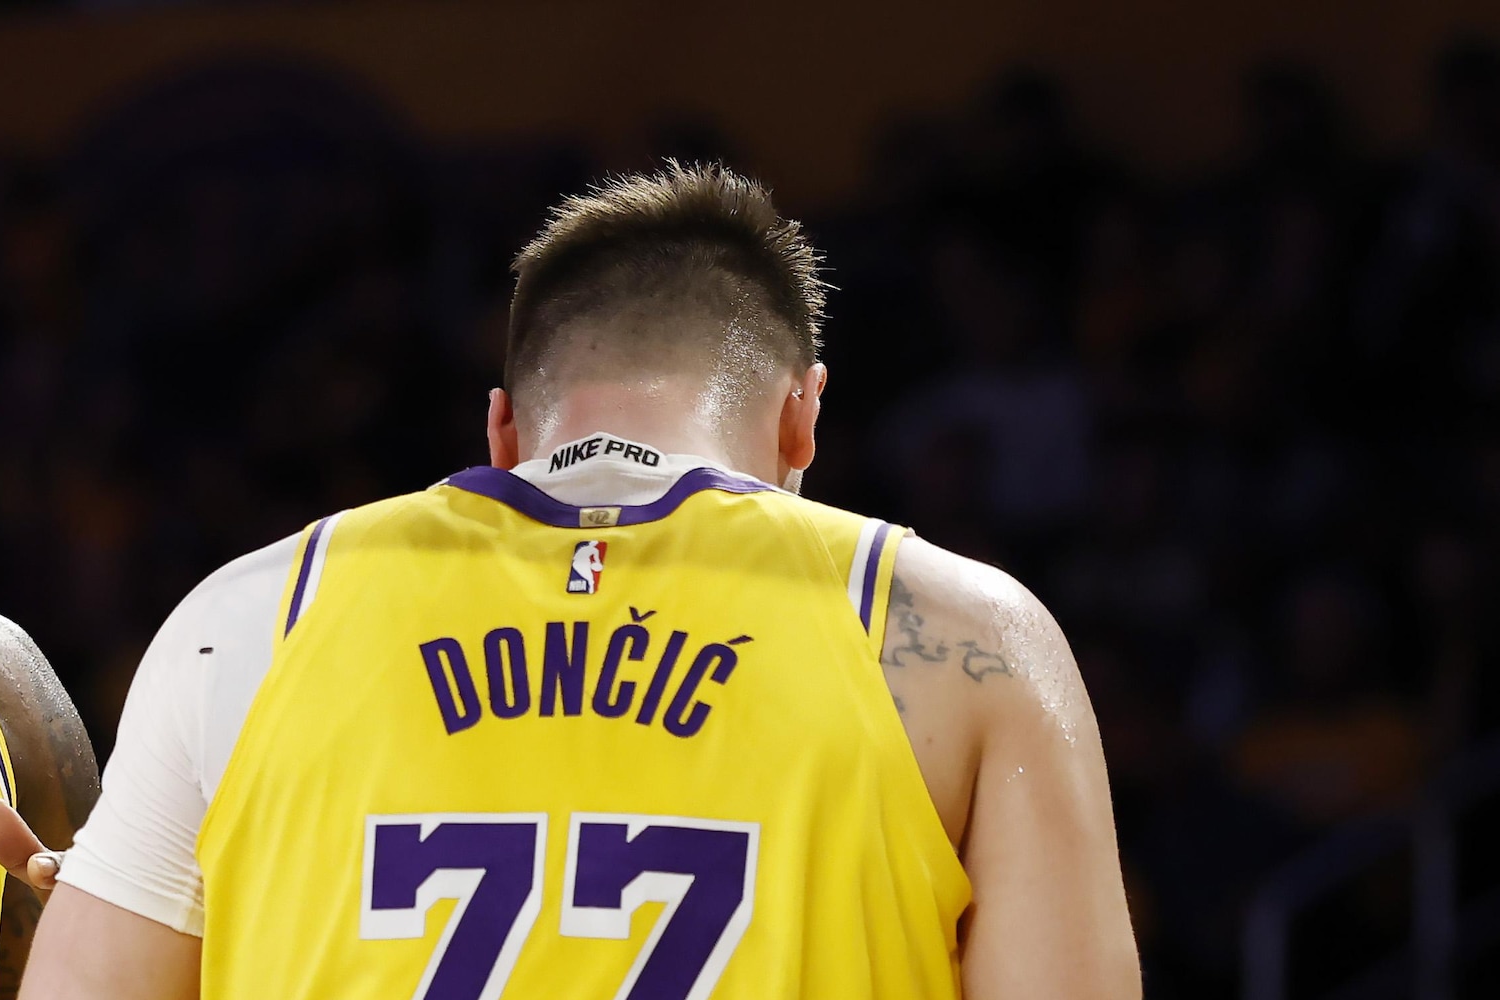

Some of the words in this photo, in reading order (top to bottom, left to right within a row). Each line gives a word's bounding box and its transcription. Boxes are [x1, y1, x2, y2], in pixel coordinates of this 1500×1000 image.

[548, 438, 603, 474] NIKE
[604, 440, 660, 467] PRO
[419, 606, 754, 738] DONČIĆ
